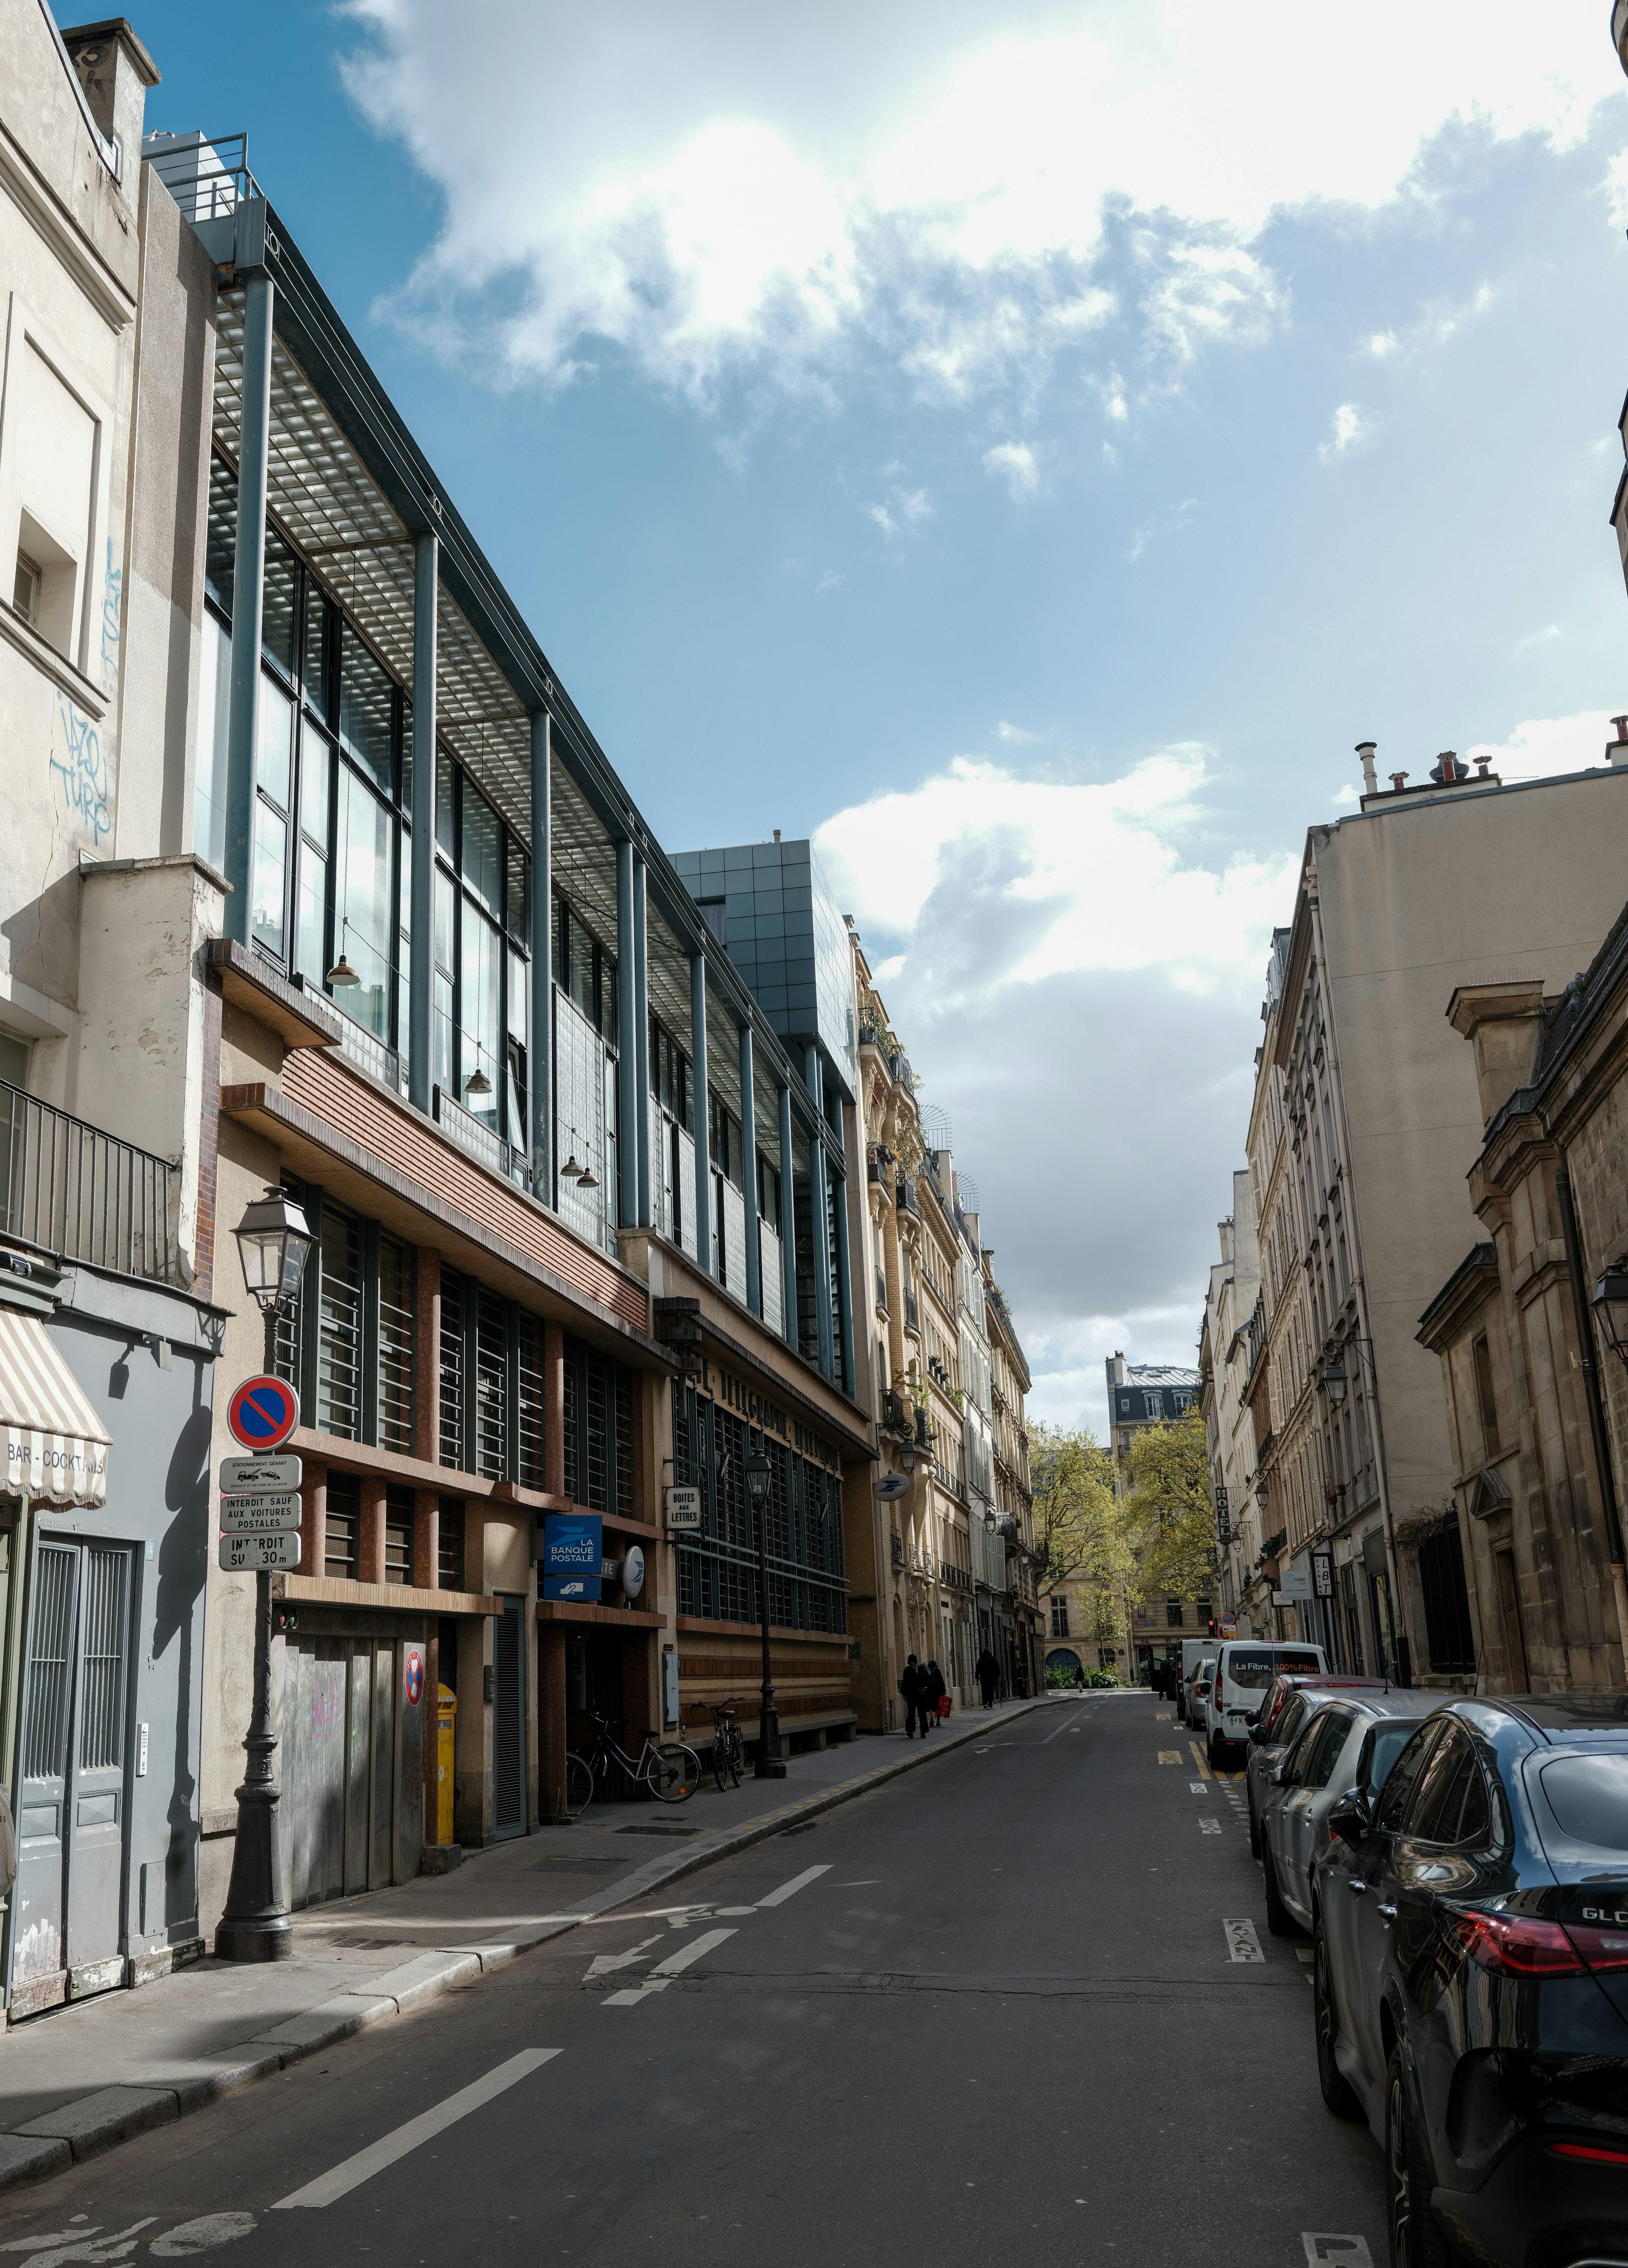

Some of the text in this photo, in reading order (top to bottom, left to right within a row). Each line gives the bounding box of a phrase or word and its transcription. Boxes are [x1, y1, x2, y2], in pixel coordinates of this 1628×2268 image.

[8, 1443, 31, 1464] BAR
[43, 1450, 103, 1475] COCKTAILS
[227, 1497, 292, 1508] INTERDIT SAUF
[673, 1493, 695, 1503] BOITES
[228, 1508, 291, 1518] AUX VOITURES
[672, 1512, 697, 1522] LETTRES
[1216, 1489, 1230, 1536] HOTEL
[238, 1519, 280, 1528] POSTALES
[147, 1545, 153, 1554] 14
[232, 1537, 284, 1551] INTRDIT
[262, 1551, 277, 1564] 30
[1322, 1559, 1330, 1593] LBT
[1248, 1663, 1271, 1671] Fibre,
[1583, 1908, 1628, 1922] GLC
[1228, 1920, 1258, 1961] PAYANT
